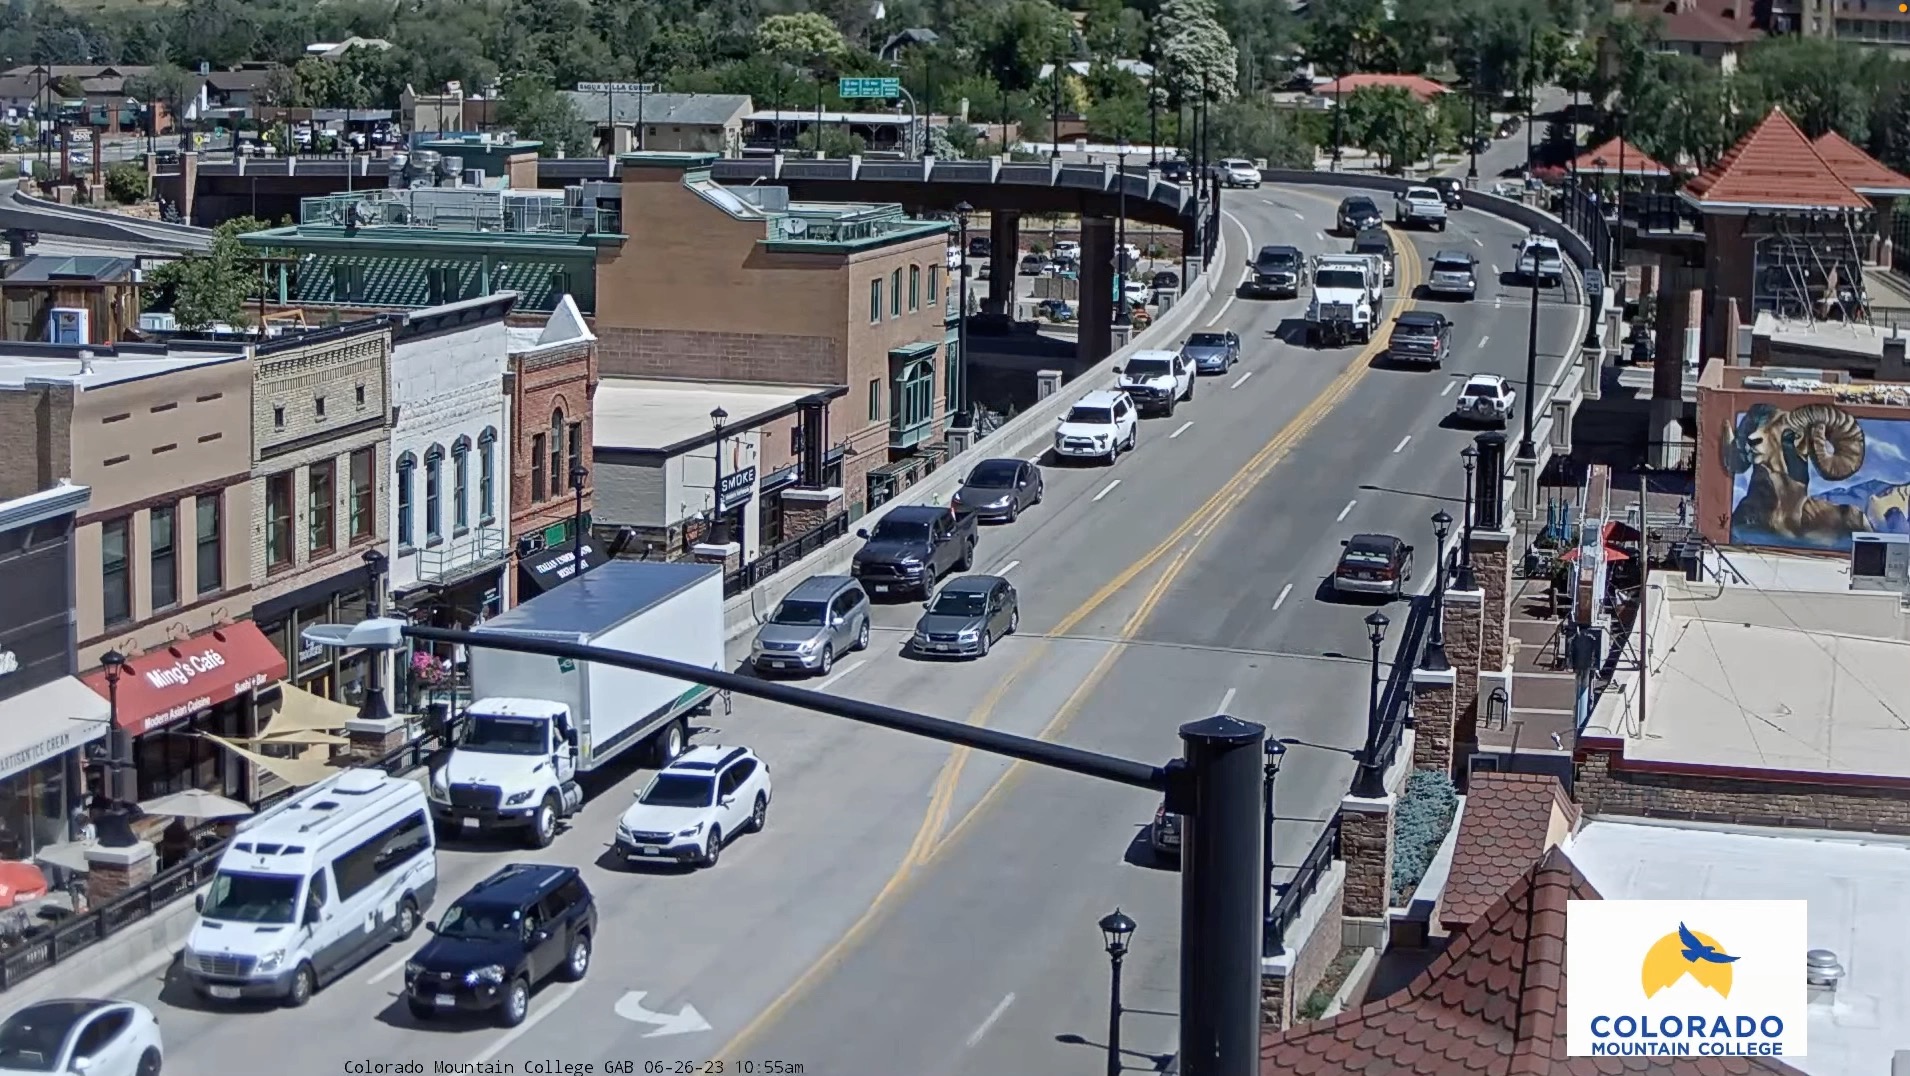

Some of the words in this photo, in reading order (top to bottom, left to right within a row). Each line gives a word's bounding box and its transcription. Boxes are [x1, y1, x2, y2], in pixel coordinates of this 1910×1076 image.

[1586, 282, 1599, 292] 25
[721, 469, 754, 492] SMOKE
[189, 648, 226, 673] Café
[256, 673, 268, 686] Bar
[144, 712, 169, 730] Modern
[169, 704, 188, 720] Asian
[187, 696, 211, 713] Cuisine
[0, 751, 31, 771] ARTISAN
[32, 742, 45, 759] ICE
[46, 733, 70, 753] CREAM
